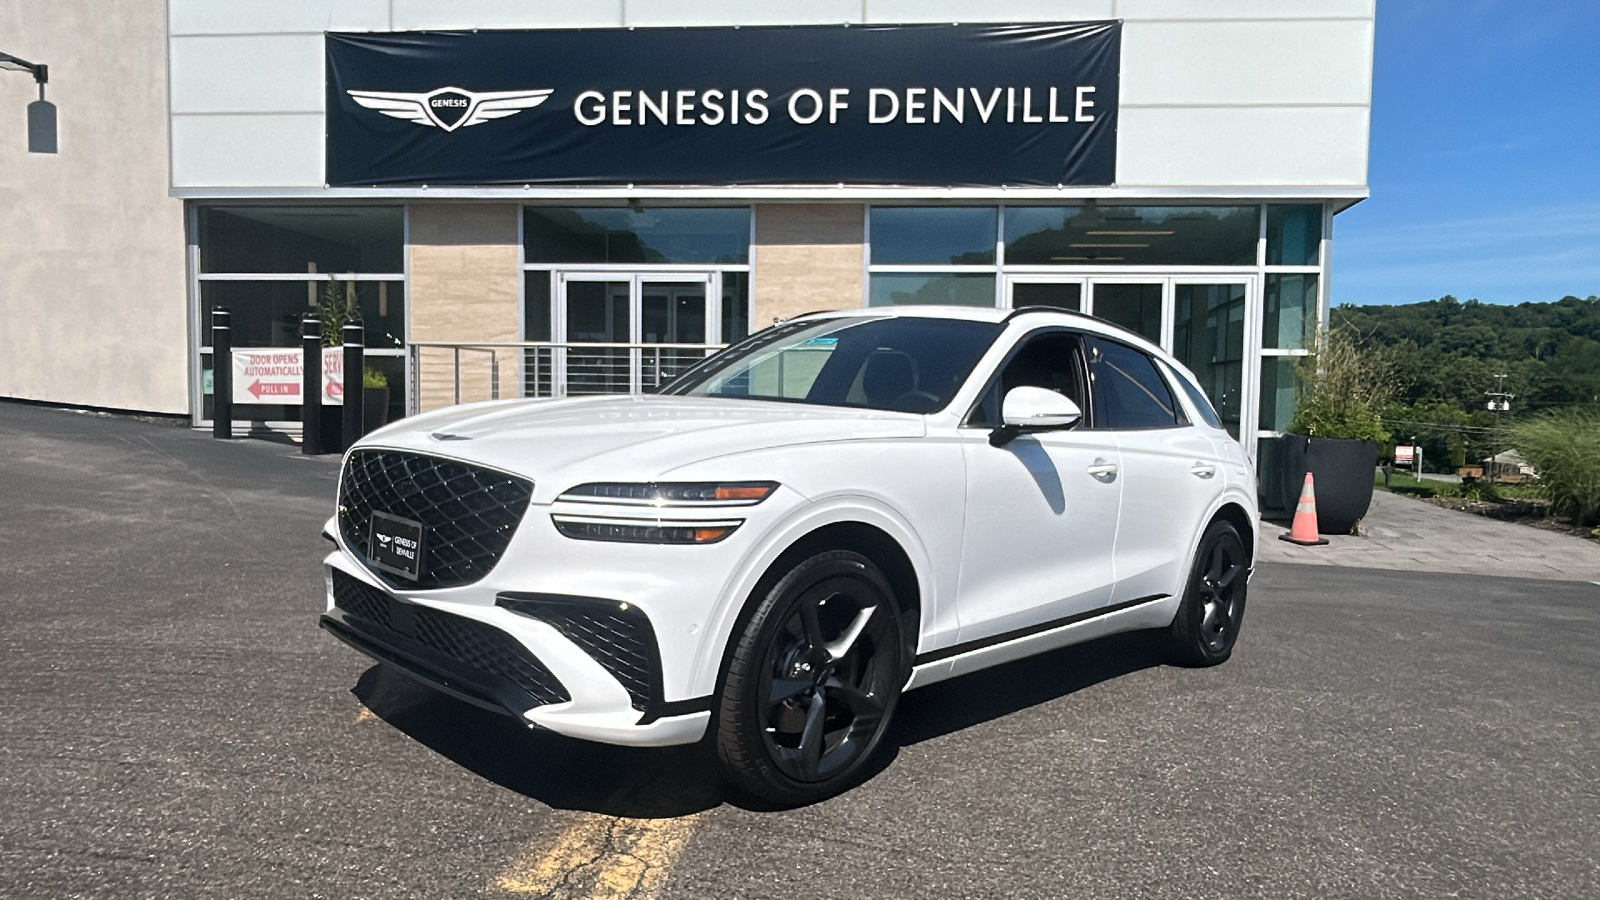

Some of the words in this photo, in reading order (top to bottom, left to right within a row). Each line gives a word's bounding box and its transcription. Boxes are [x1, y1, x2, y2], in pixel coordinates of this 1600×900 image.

[431, 99, 468, 108] GENESIS
[574, 89, 769, 126] GENESIS
[787, 88, 850, 125] OF
[868, 86, 1096, 124] DENVILLE
[250, 355, 271, 365] DOOR
[272, 354, 299, 364] OPENS
[261, 384, 278, 394] PULL
[280, 384, 289, 394] IN
